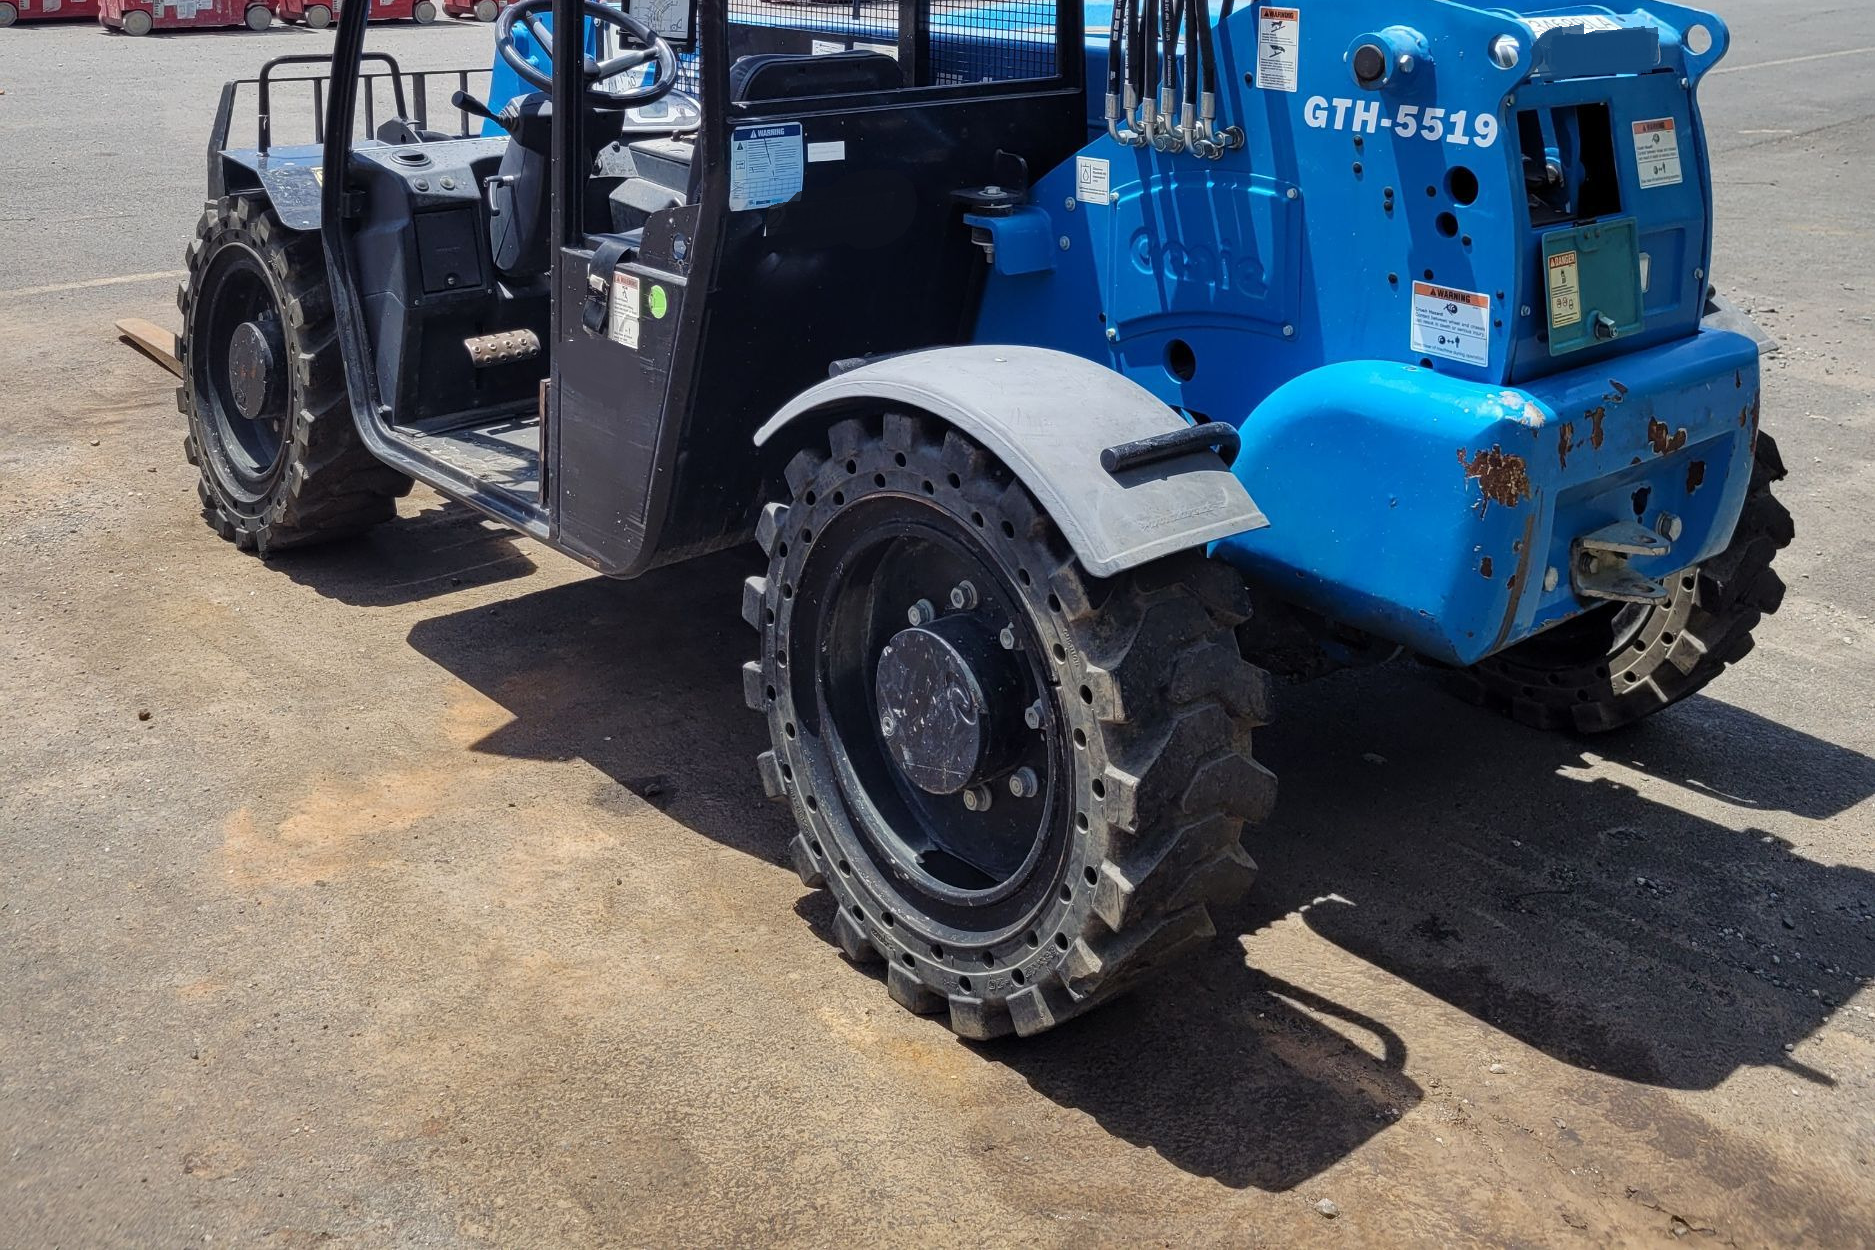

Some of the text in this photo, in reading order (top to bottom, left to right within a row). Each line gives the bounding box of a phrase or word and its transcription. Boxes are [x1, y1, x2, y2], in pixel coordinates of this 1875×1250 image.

[1304, 95, 1498, 148] GTH-5519
[757, 127, 785, 138] WARNING
[1555, 253, 1576, 267] DANGER
[1438, 290, 1471, 303] WARNING
